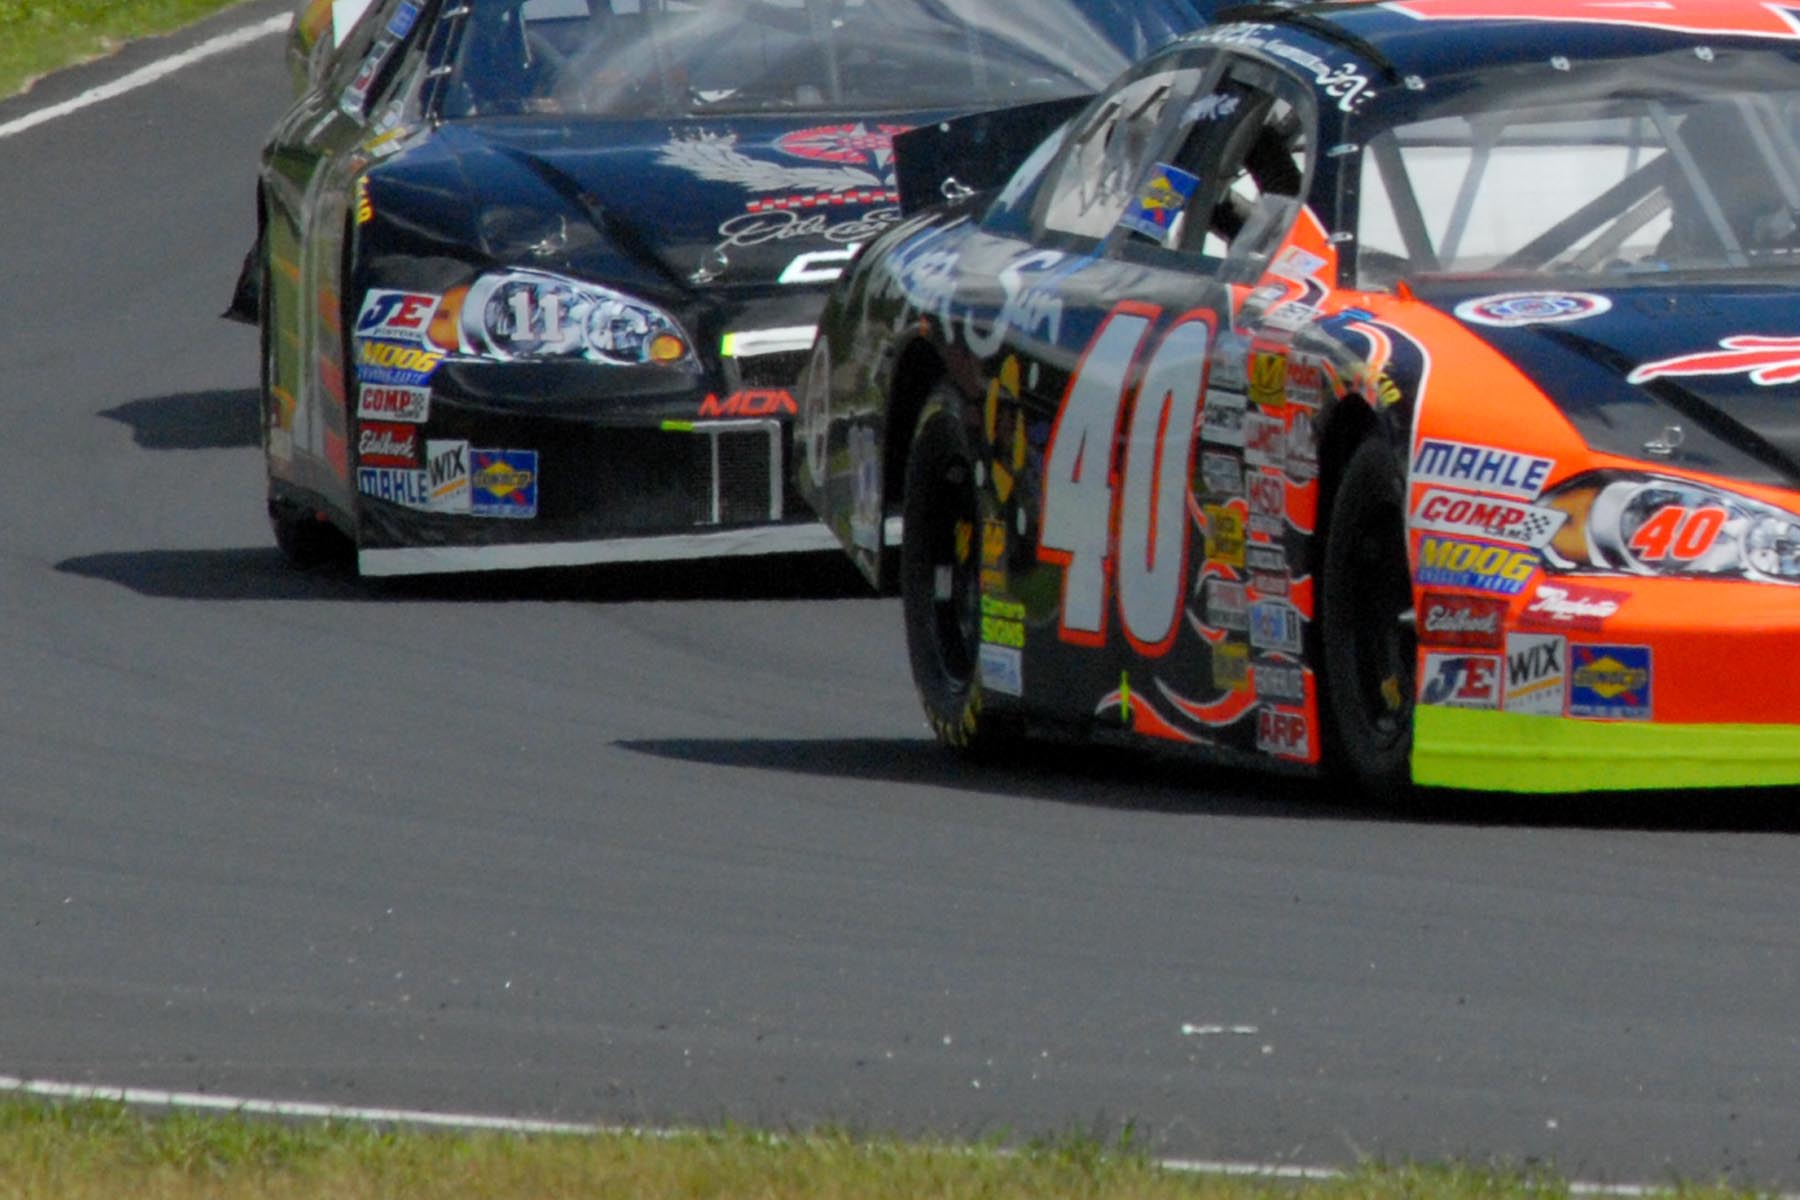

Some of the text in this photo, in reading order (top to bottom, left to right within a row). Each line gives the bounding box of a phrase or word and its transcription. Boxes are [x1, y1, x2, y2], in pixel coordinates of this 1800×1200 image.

[358, 293, 434, 333] JE
[508, 291, 565, 341] 11
[362, 340, 442, 372] MOOG
[362, 388, 412, 412] COMP
[360, 468, 428, 502] MAHLE
[429, 444, 466, 486] WIX
[1037, 299, 1219, 657] 40
[1412, 441, 1551, 498] MAHLE
[1420, 494, 1527, 530] COMP
[1628, 505, 1728, 561] 40
[1421, 538, 1541, 583] MOOG
[1421, 656, 1498, 706] JE
[1507, 638, 1561, 686] WIX
